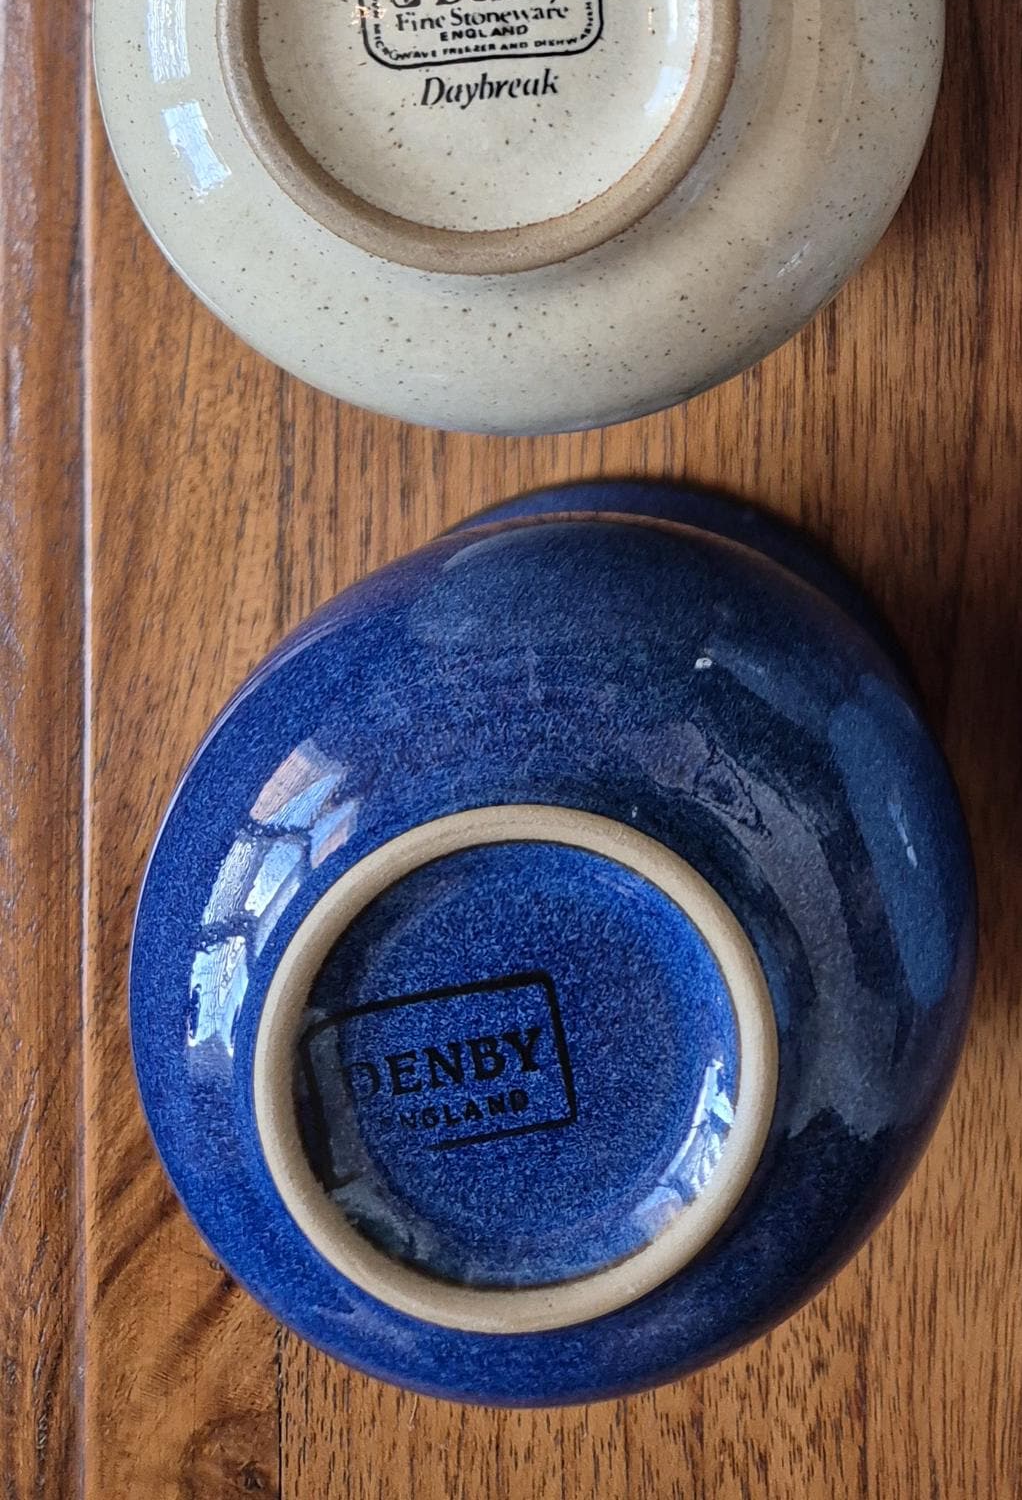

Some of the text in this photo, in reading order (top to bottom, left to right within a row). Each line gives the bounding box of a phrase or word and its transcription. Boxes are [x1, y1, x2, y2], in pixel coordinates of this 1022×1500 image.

[396, 7, 569, 32] Fine Stoneware
[440, 24, 529, 42] ENGLAND
[501, 42, 528, 51] AND
[420, 68, 559, 110] Daybreak
[342, 1027, 542, 1099] DENBY
[379, 1089, 529, 1130] NGLAND
